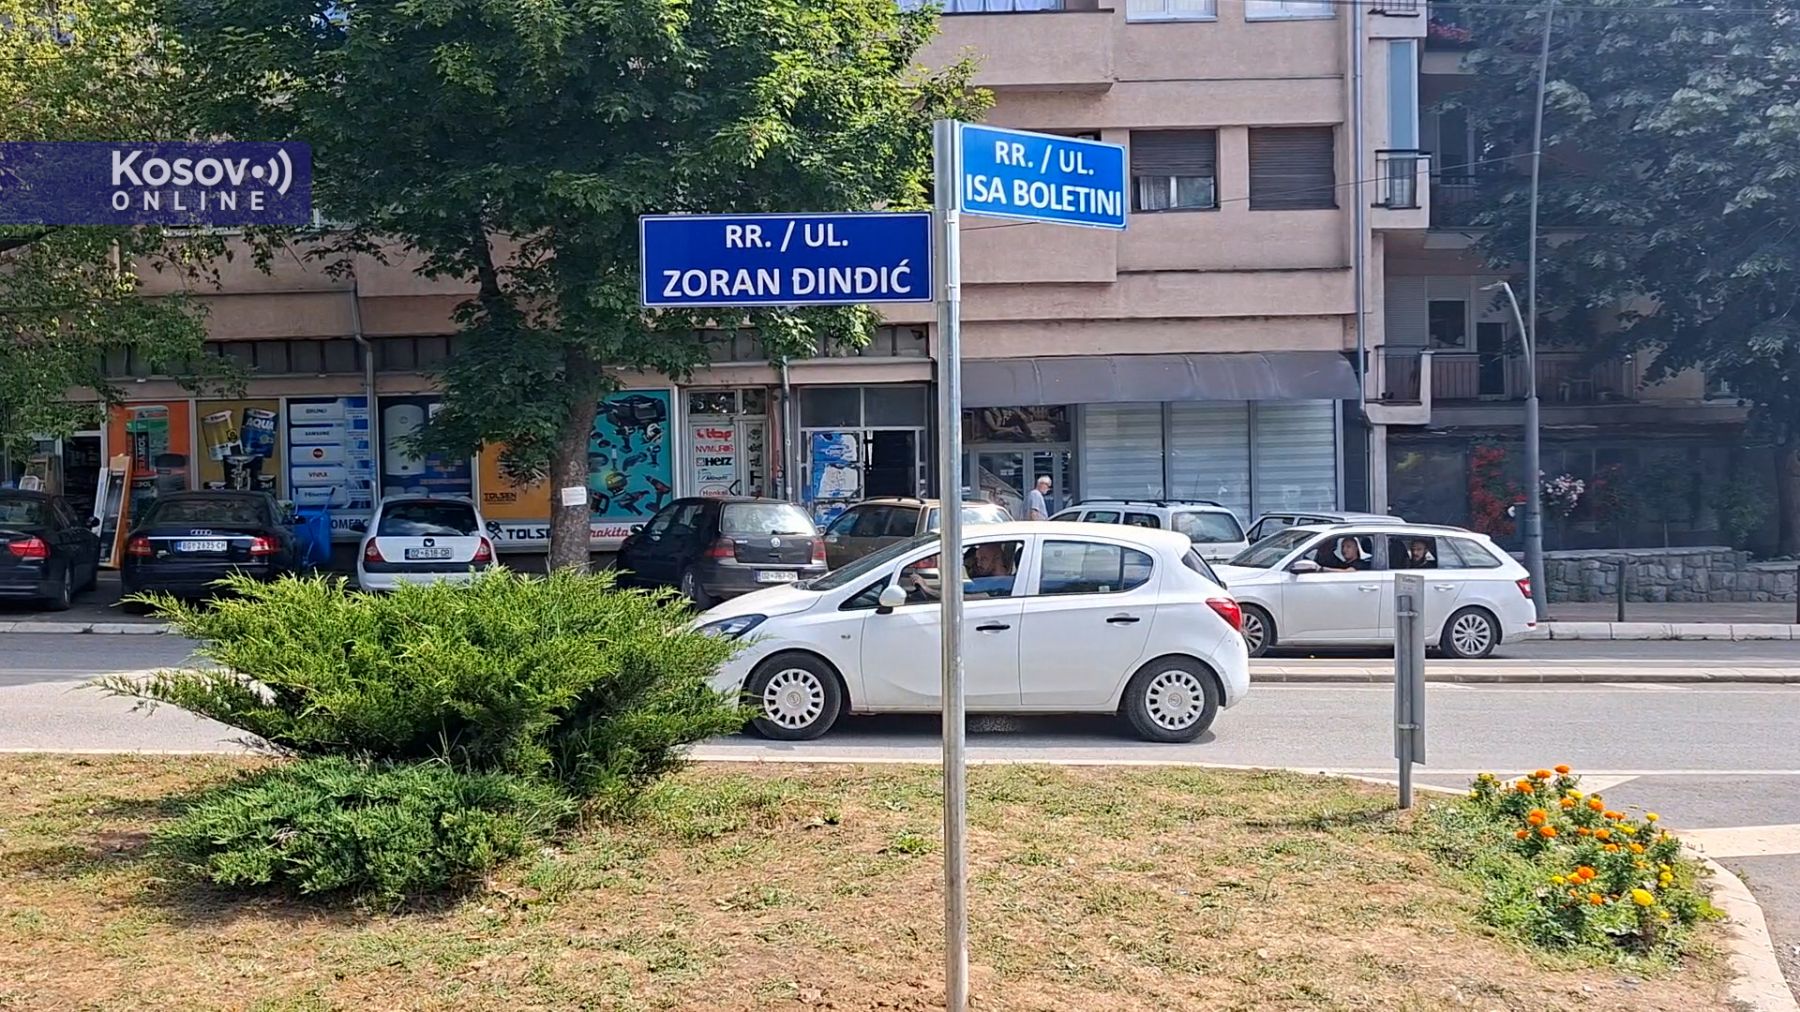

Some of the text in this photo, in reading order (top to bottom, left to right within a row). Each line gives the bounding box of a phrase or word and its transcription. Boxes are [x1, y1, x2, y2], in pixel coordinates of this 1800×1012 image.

[995, 140, 1095, 176] RR. / UL.
[965, 173, 1122, 217] ISA BOLETINI
[725, 220, 849, 252] RR. / UL.
[662, 268, 780, 297] ZORAN
[246, 417, 275, 430] AQUA
